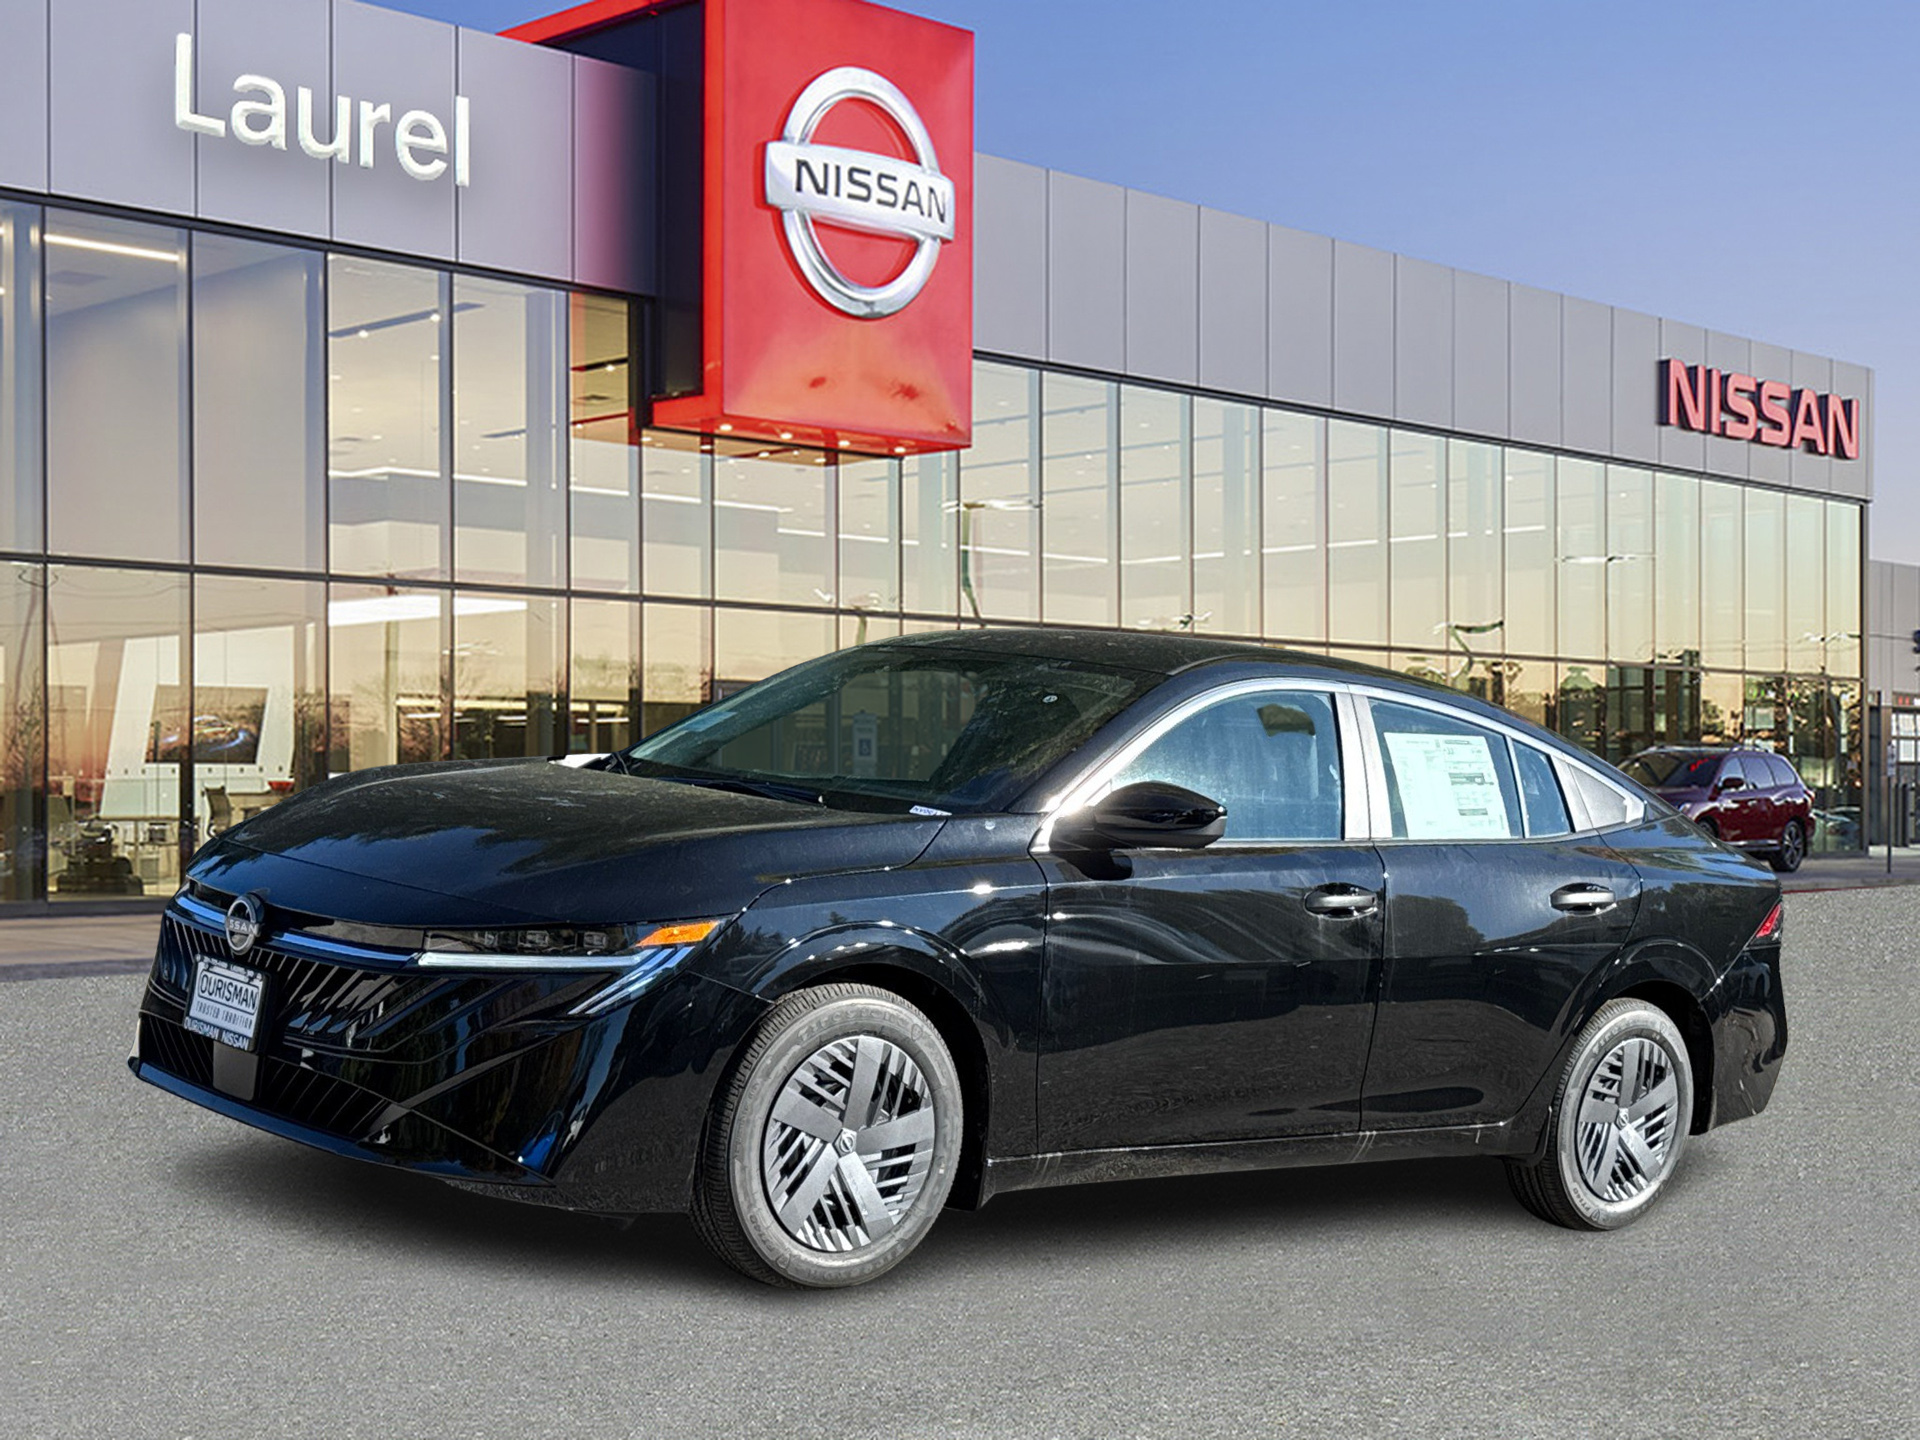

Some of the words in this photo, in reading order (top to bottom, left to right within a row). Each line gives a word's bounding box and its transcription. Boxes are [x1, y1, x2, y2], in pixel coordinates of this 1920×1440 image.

[175, 33, 469, 187] Laurel
[795, 159, 946, 223] NISSAN
[1666, 358, 1859, 459] NISSAN
[229, 919, 258, 936] SSAN
[200, 974, 258, 1011] OURISMAN
[184, 1016, 219, 1040] OURISMAN
[221, 1029, 250, 1050] NISSAN
